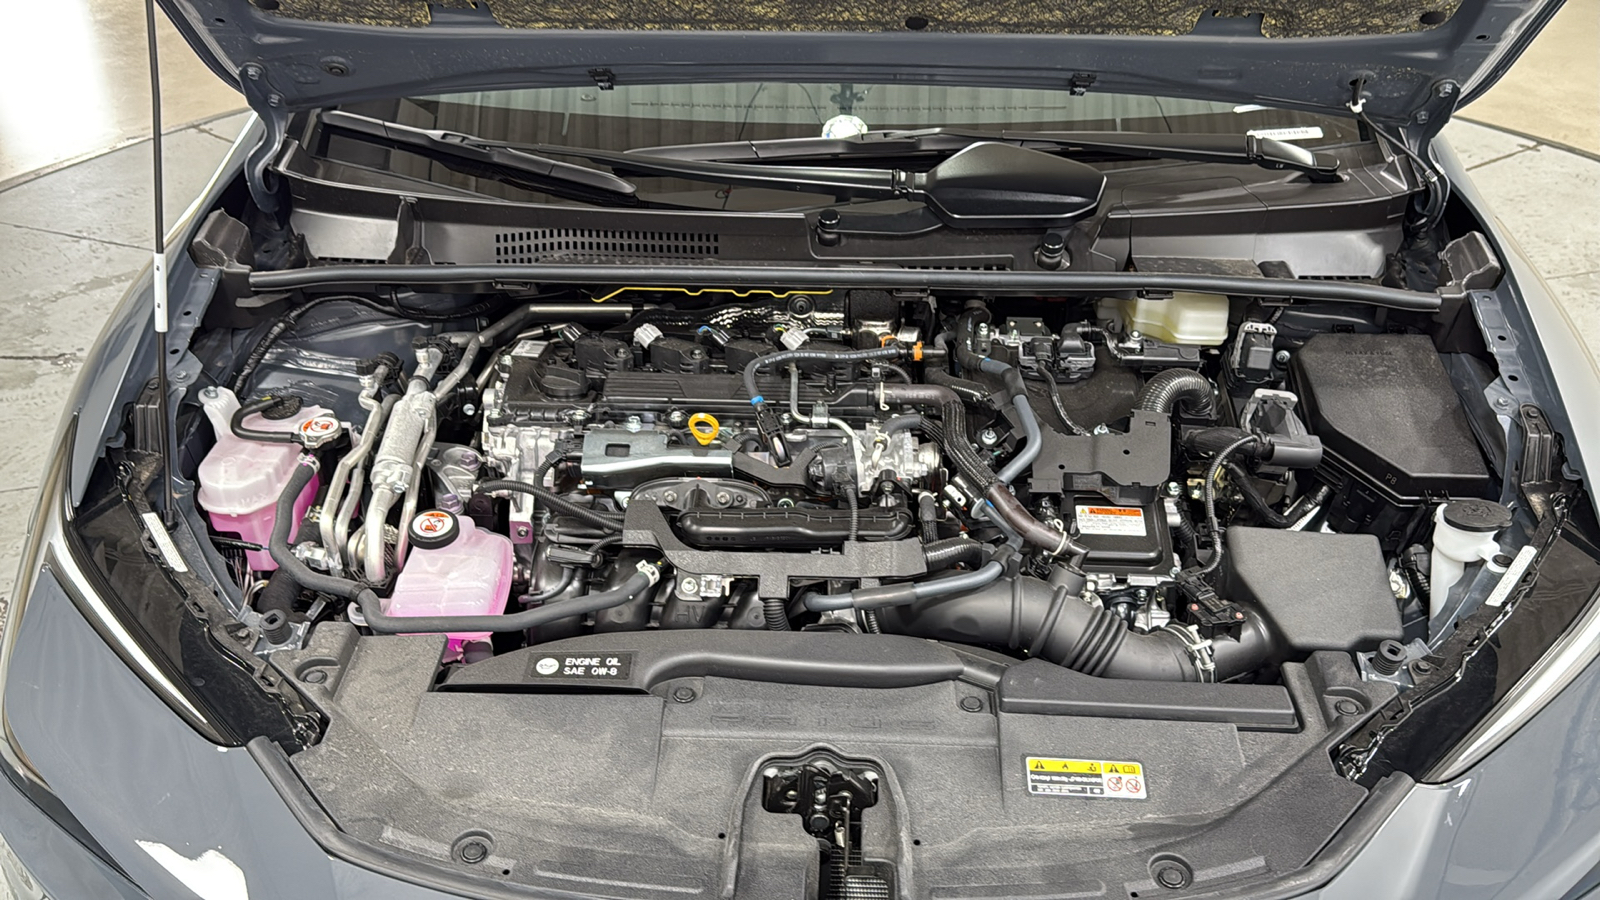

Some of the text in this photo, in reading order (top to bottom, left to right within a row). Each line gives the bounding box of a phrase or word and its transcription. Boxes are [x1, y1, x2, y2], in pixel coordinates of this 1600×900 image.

[1385, 472, 1398, 485] P8
[675, 604, 706, 623] HV
[564, 657, 621, 666] ENGINE OIL
[563, 667, 585, 675] SAE
